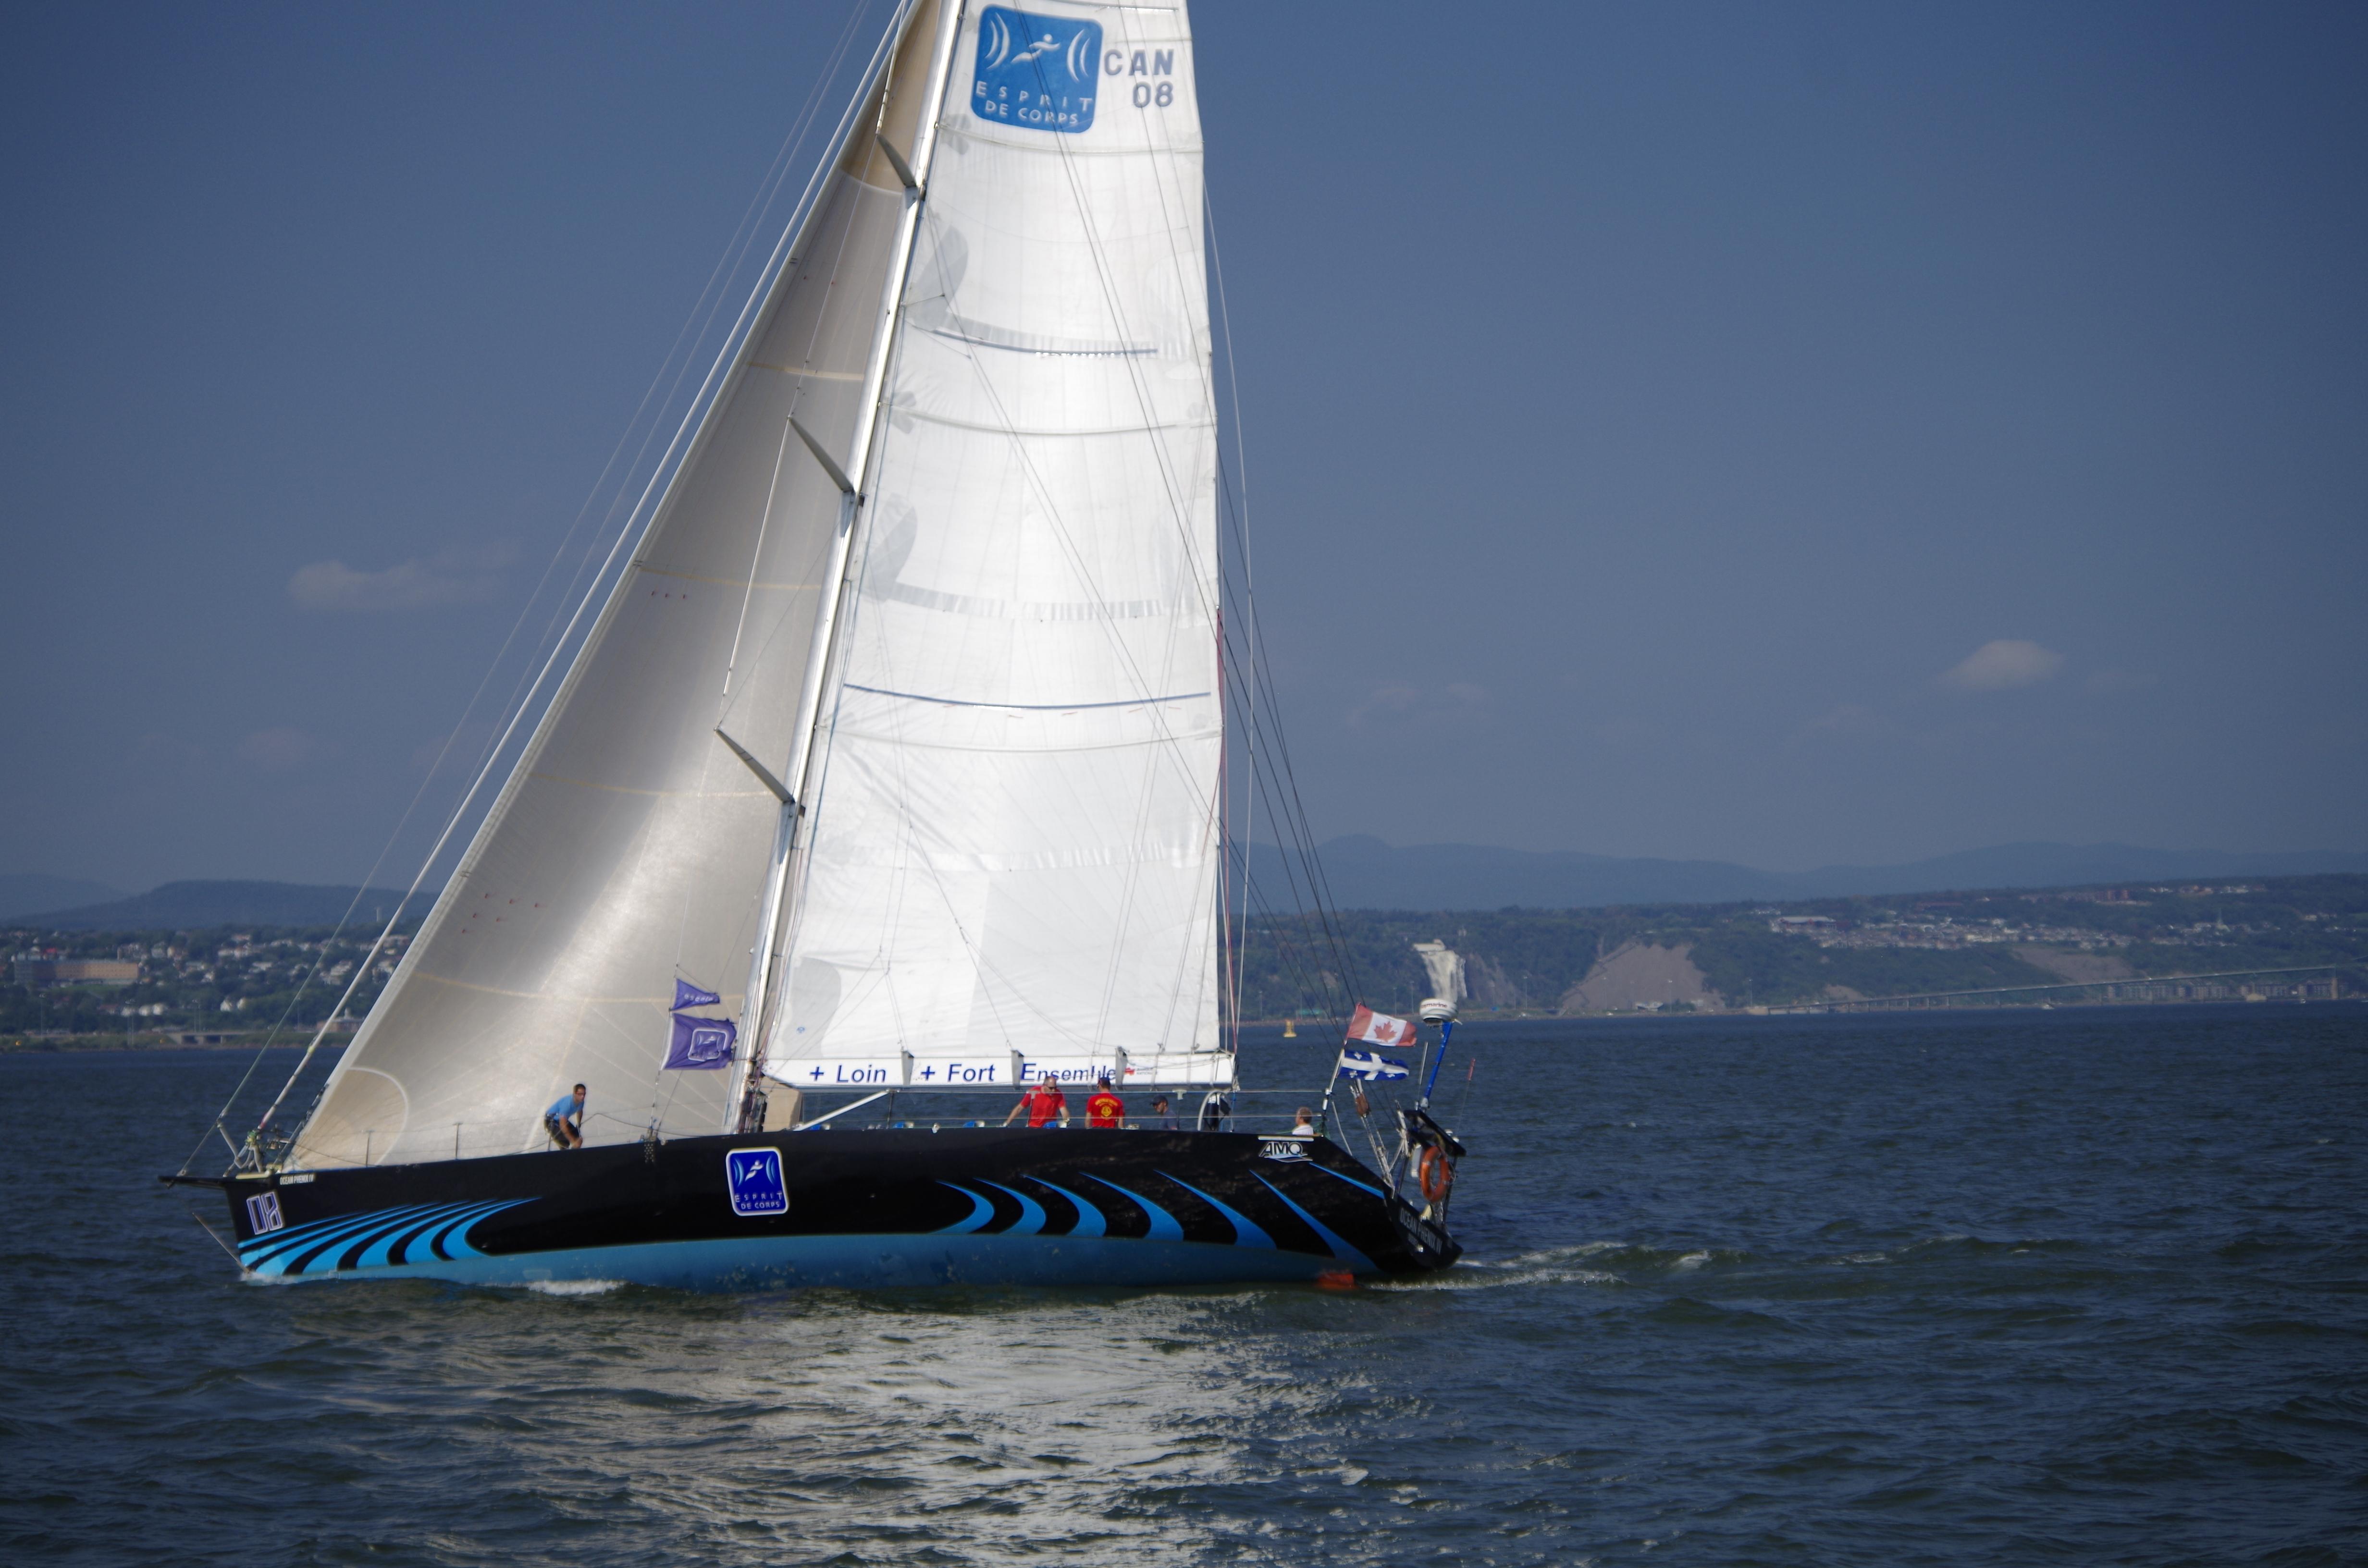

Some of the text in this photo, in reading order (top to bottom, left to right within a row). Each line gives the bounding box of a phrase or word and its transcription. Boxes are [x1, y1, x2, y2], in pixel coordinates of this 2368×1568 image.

[1105, 49, 1174, 76] CAN
[976, 80, 1093, 112] ESPRIT
[1133, 80, 1173, 109] 08
[986, 100, 1078, 124] DE CORPS
[836, 1064, 886, 1083] Loin
[947, 1064, 996, 1082] Fort
[1259, 1141, 1307, 1157] AMQ
[280, 1176, 293, 1185] OCEAN
[734, 1191, 783, 1202] ESPRIT
[247, 1191, 283, 1235] 08
[1400, 1207, 1418, 1235] OCEAN
